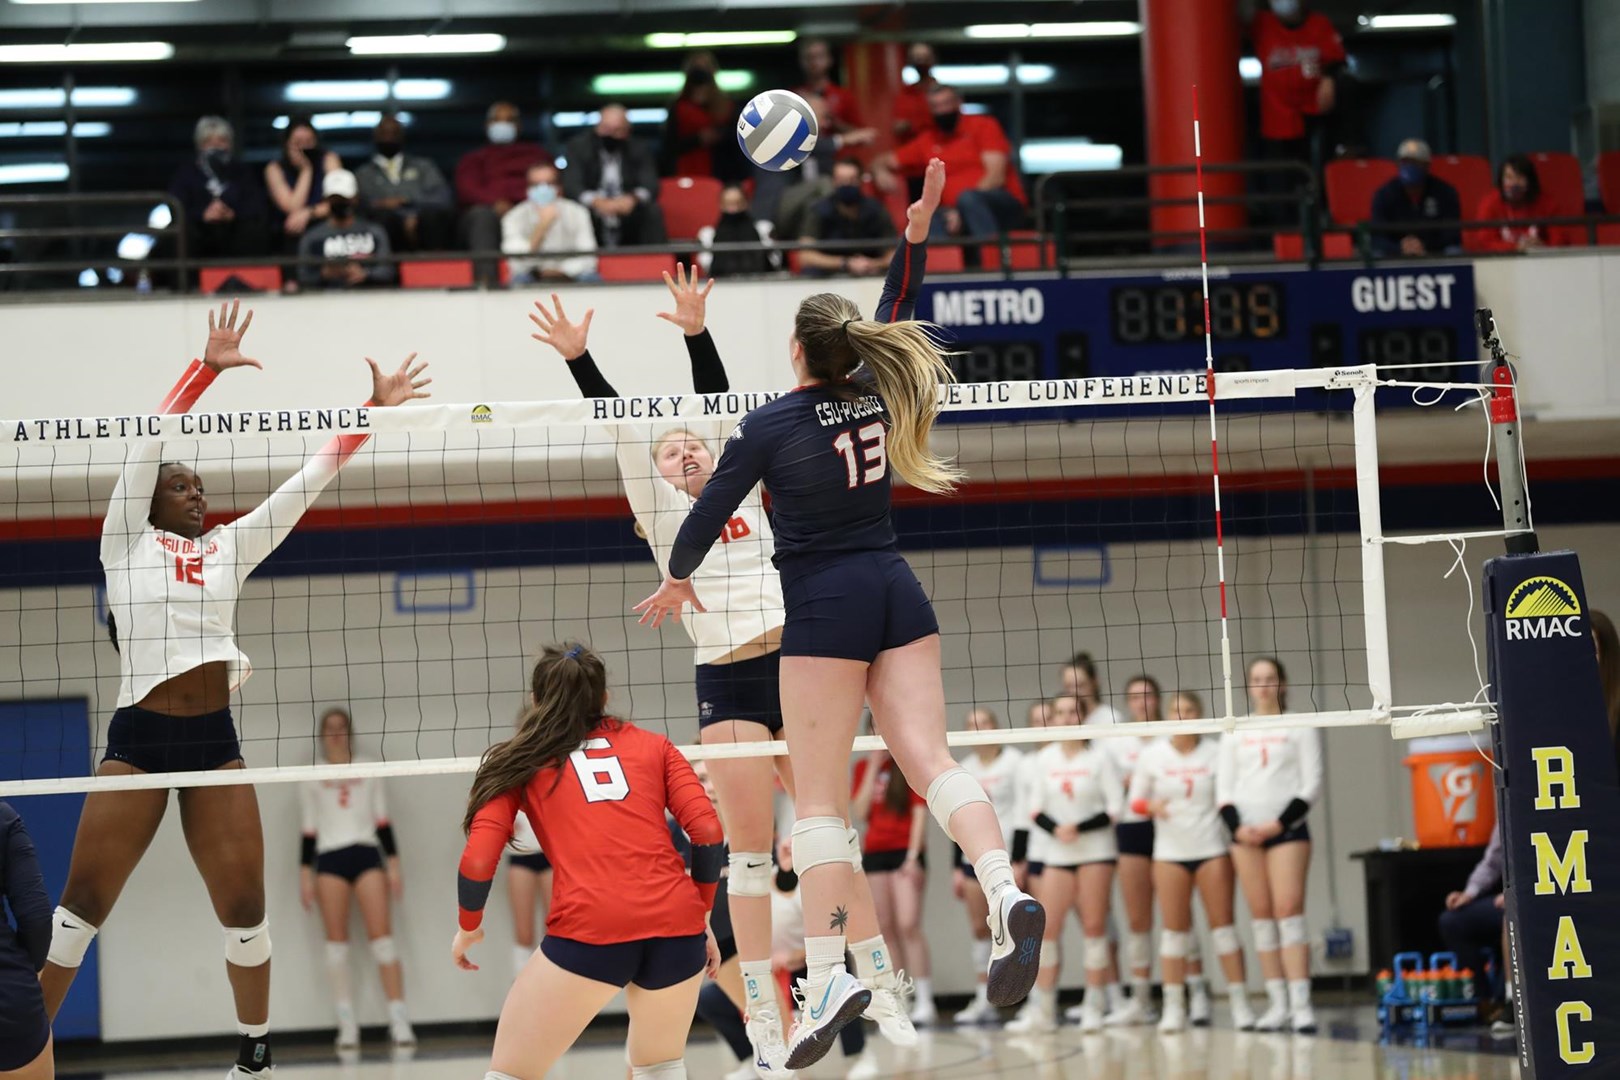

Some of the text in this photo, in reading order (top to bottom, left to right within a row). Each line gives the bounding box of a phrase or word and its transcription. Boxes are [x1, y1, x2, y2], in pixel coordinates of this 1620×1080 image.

[932, 287, 1044, 326] METRO
[1351, 273, 1456, 313] GUEST
[593, 396, 683, 419] ROCKY
[703, 392, 790, 415] MOUN
[1029, 375, 1208, 401] CONFERENCE
[14, 407, 371, 442] ATHLETIC CONFERENCE
[832, 421, 888, 489] 13
[175, 555, 205, 587] 12
[1505, 615, 1582, 641] RMAC
[568, 737, 631, 804] 6
[1446, 766, 1473, 798] G
[1509, 921, 1529, 1068] sports imports
